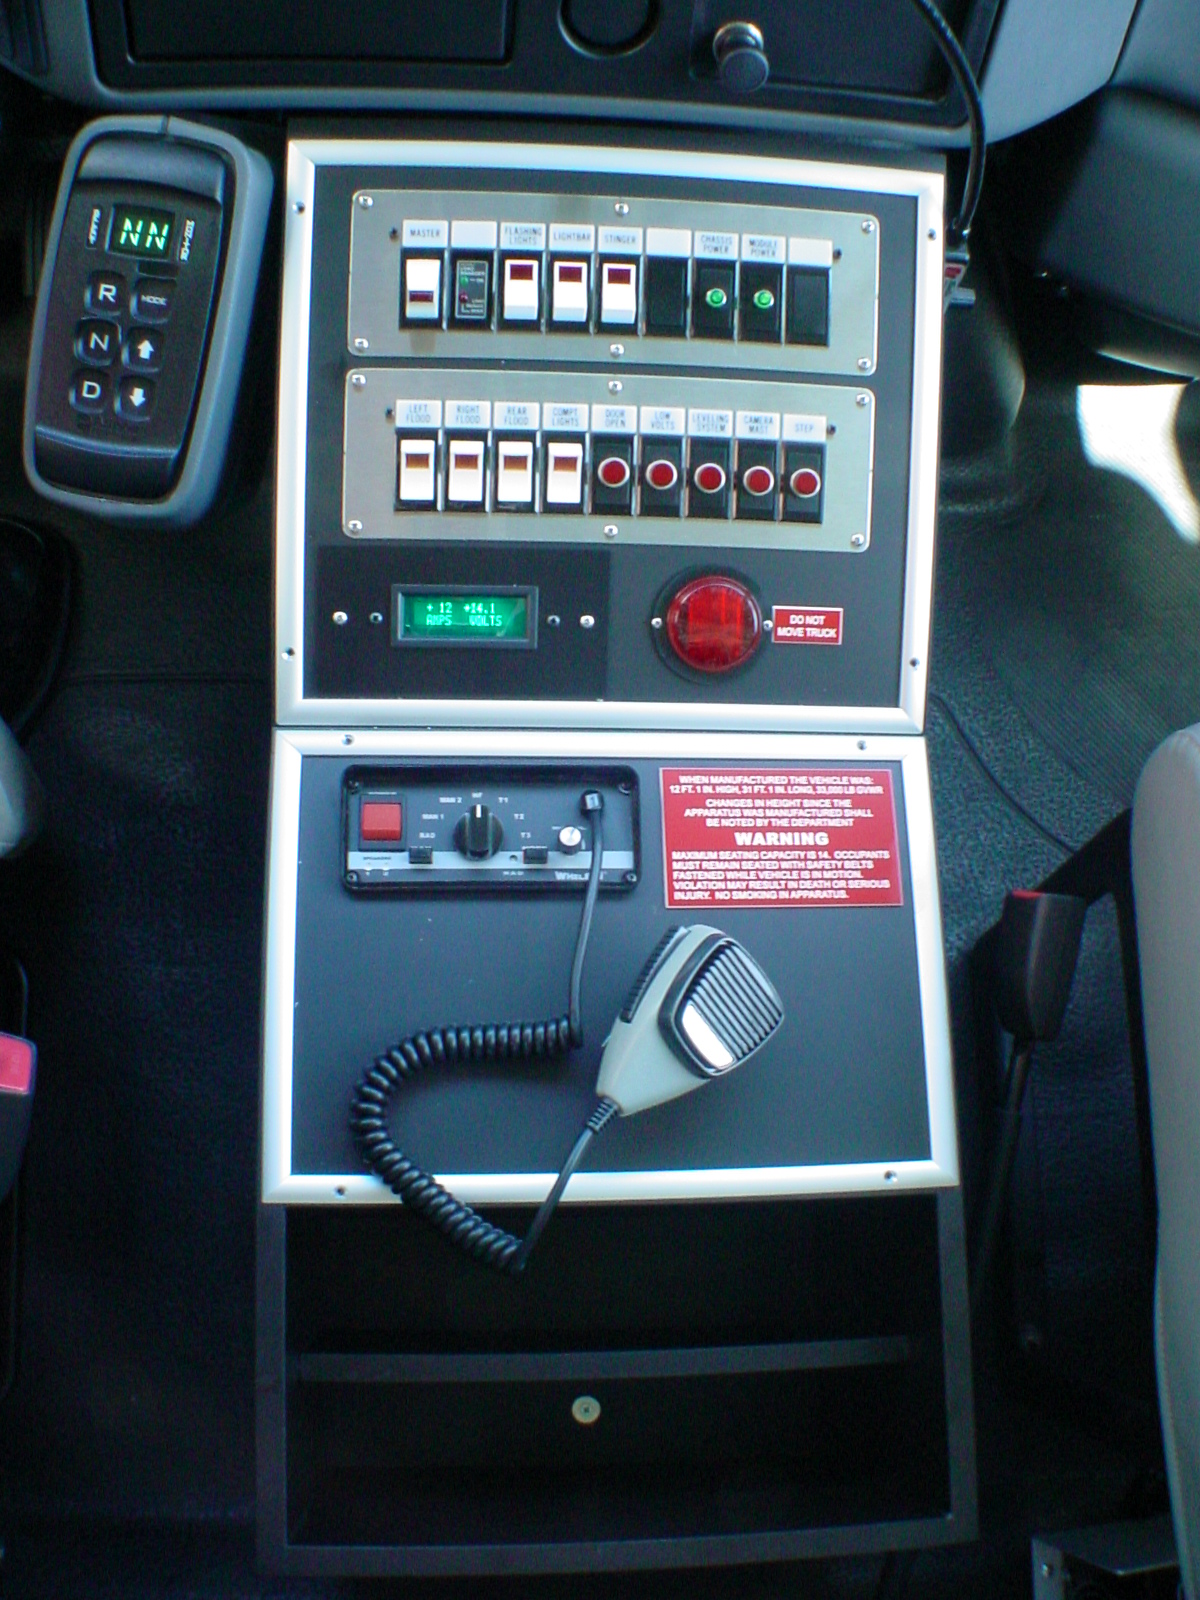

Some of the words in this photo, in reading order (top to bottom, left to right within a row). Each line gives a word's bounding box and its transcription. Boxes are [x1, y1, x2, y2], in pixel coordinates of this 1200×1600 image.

[409, 228, 441, 238] MASTER
[504, 226, 543, 236] FLASHING
[553, 231, 591, 241] LIGHTBAR
[508, 236, 538, 246] LIGHTS
[604, 234, 637, 244] STINGER
[700, 234, 733, 245] CHASSIS
[748, 238, 778, 248] MODULE
[702, 243, 729, 254] POWER
[750, 248, 776, 258] POWER
[98, 283, 117, 303] R
[89, 332, 109, 351] N
[82, 381, 101, 399] D
[408, 404, 428, 414] LEFT
[456, 405, 480, 414] RIGHT
[507, 406, 527, 415] REAR
[605, 409, 625, 419] DOOR
[406, 413, 431, 423] FLOOD
[455, 414, 480, 424] FLOOD
[504, 416, 529, 426] FLOOD
[654, 411, 671, 421] LOW
[692, 414, 729, 424] LEVELING
[744, 415, 774, 425] CAMERA
[552, 417, 579, 427] LIGHTS
[605, 418, 626, 428] OPEN
[651, 420, 675, 430] VOLTS
[697, 422, 726, 432] SYSTEM
[749, 424, 768, 434] MAST
[795, 423, 814, 433] STEP
[426, 614, 453, 626] AMPS
[468, 615, 503, 627] VOLTS
[789, 614, 804, 625] DO
[805, 615, 826, 626] NOT
[777, 627, 804, 638] MOVE
[806, 628, 837, 638] TRUCK
[679, 776, 709, 784] WHEN
[710, 776, 788, 784] MANUFACTURED
[789, 776, 808, 784] THE
[809, 776, 849, 784] VEHICLE
[705, 799, 753, 807] CHANGES
[766, 799, 802, 807] HEIGHT
[803, 799, 832, 807] SINCE
[833, 799, 852, 807] THE
[684, 808, 741, 817] APPARATUS
[742, 808, 764, 817] WAS
[765, 808, 843, 817] MANUFACTURED
[844, 808, 874, 817] SHALL
[721, 818, 755, 827] NOTED
[771, 818, 790, 827] THE
[791, 818, 854, 827] DEPARTMENT
[734, 832, 829, 846] WARNING
[672, 851, 717, 859] MAXIMUM
[718, 851, 759, 859] SEATING
[760, 851, 805, 859] CAPACITY
[834, 851, 890, 859] OCCUPANTS
[672, 861, 701, 869] MUST
[702, 861, 740, 869] REMAIN
[741, 861, 780, 869] SEATED
[781, 861, 805, 869] WITH
[806, 861, 843, 869] SAFETY
[844, 861, 874, 869] BELTS
[672, 871, 725, 879] FASTENED
[726, 871, 757, 879] WHILE
[758, 871, 799, 879] VEHICLE
[673, 881, 725, 889] VIOLATION
[726, 881, 748, 889] MAY
[749, 881, 786, 889] RESULT
[799, 880, 831, 889] DEATH
[848, 880, 890, 888] SERIOUS
[732, 891, 777, 899] SMOKING
